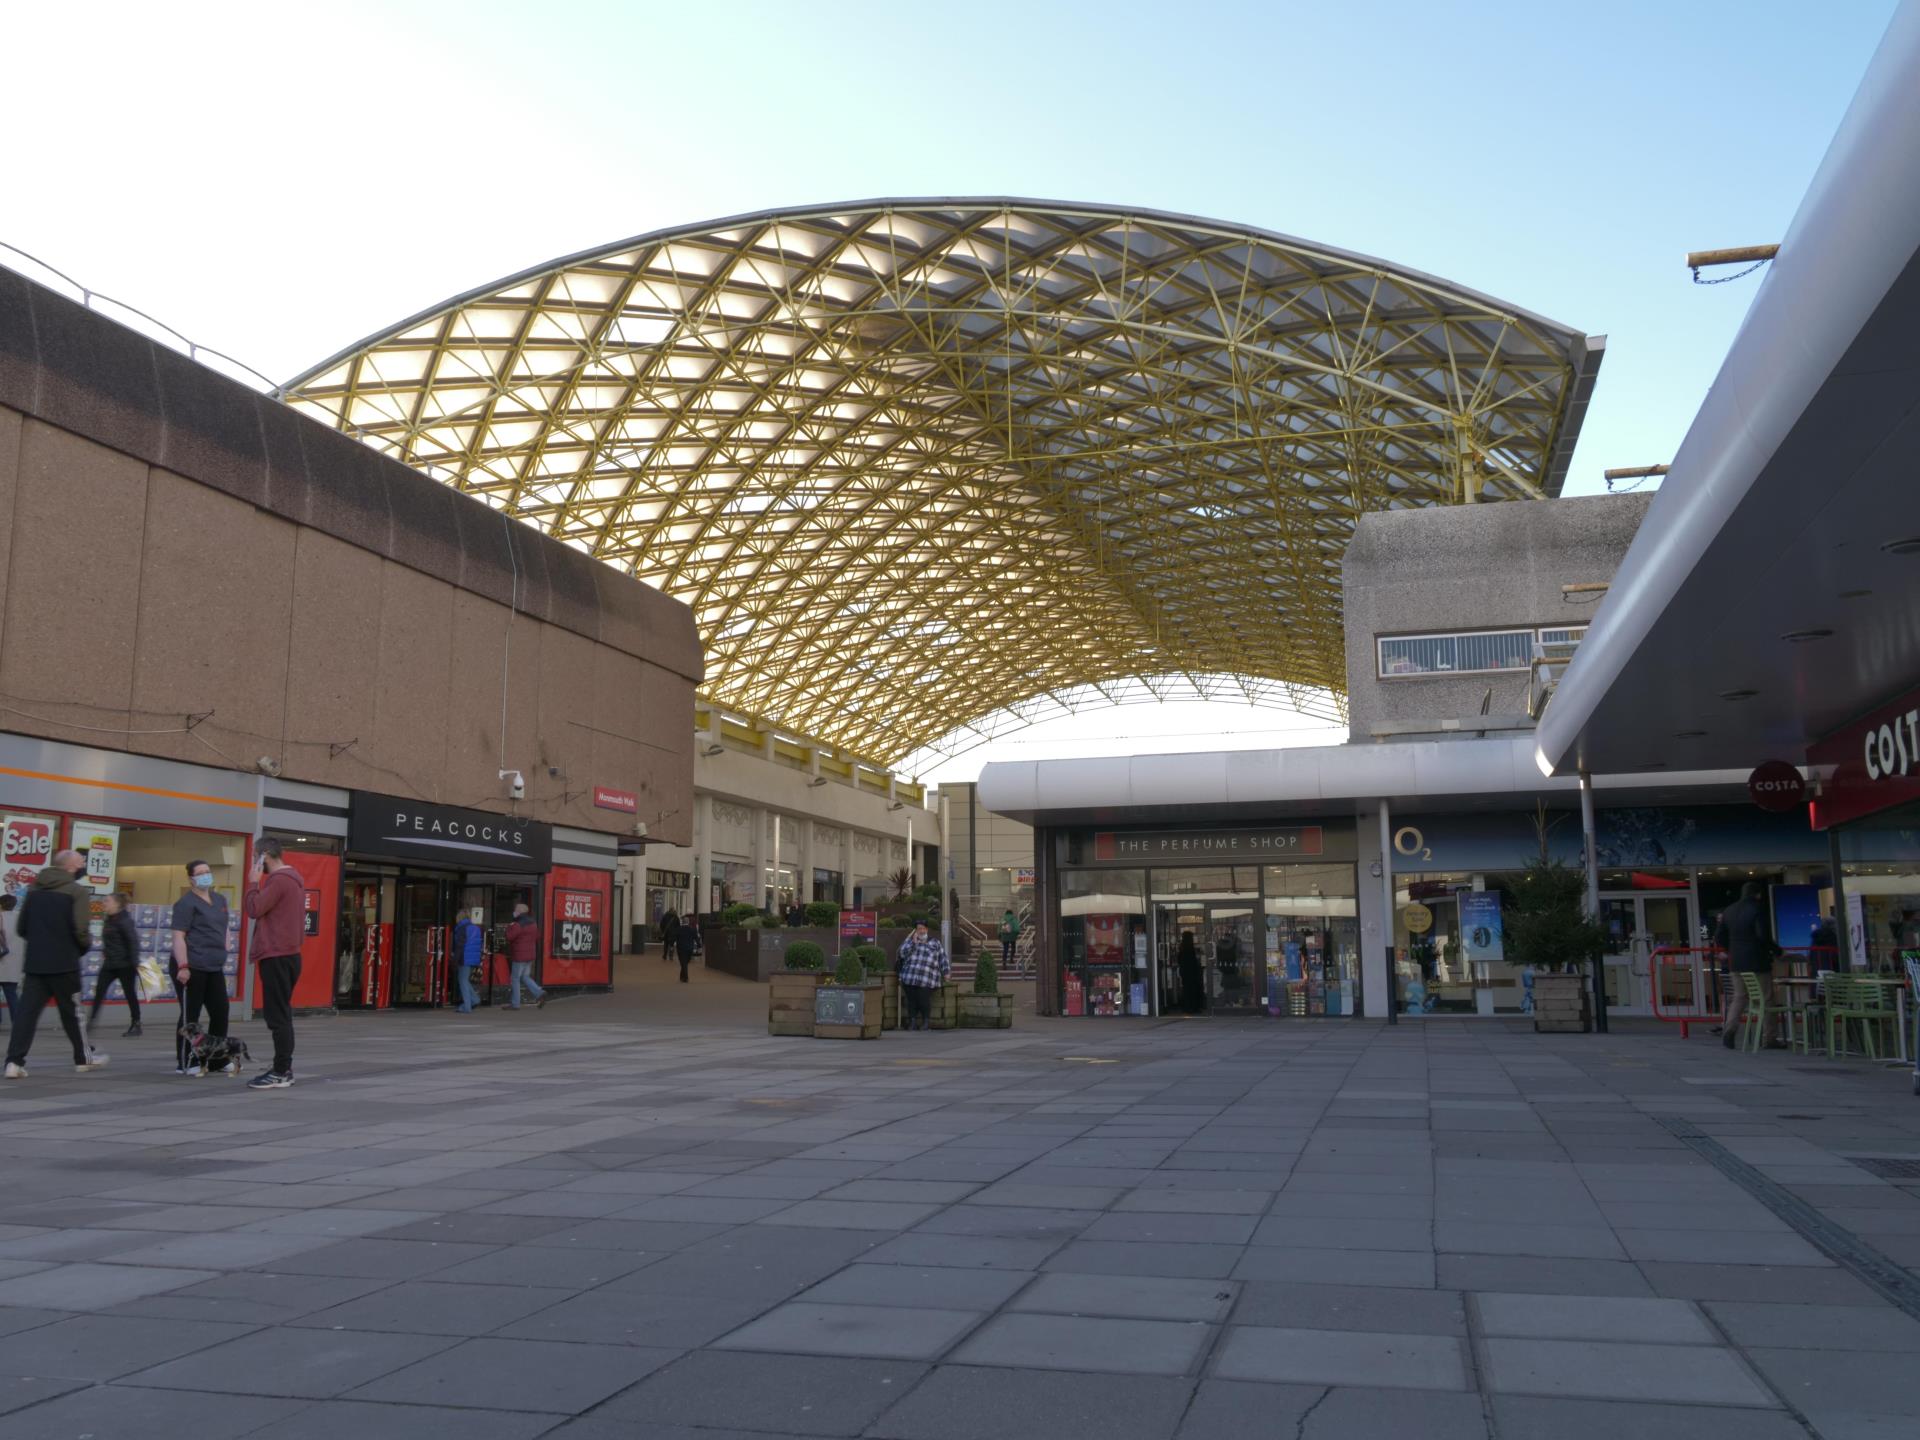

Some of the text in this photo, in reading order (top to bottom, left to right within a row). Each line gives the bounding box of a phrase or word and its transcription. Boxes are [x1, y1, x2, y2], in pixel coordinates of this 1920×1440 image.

[1755, 780, 1799, 791] COSTA
[396, 813, 523, 845] PEACOCKS
[5, 829, 50, 855] Sale
[1119, 836, 1298, 852] THE PERFUME SHOP
[565, 902, 591, 918] SALE
[562, 923, 593, 951] 50%
[581, 943, 592, 951] OFF
